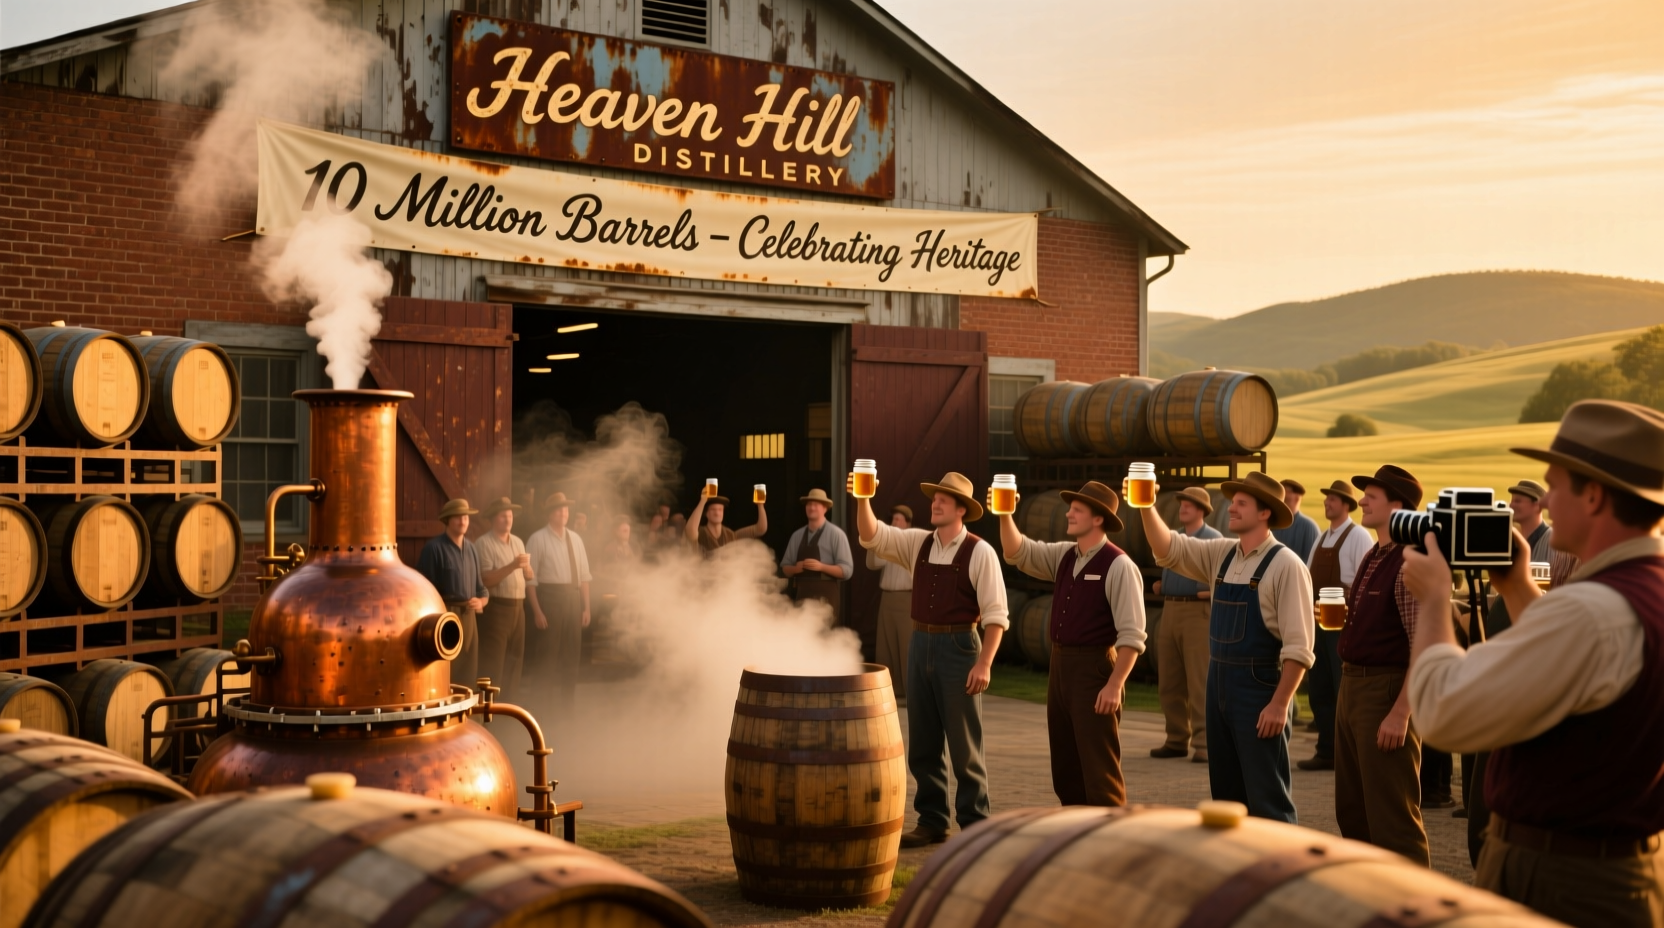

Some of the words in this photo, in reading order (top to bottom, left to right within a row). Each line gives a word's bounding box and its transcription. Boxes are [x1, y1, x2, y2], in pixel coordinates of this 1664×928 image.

[466, 47, 722, 141] Heaven
[737, 84, 860, 158] Hill
[633, 143, 843, 187] DISTILLERY
[301, 160, 368, 216] 10
[374, 172, 547, 238] Million
[555, 193, 699, 252] Barrels
[738, 214, 903, 283] Celebrating
[911, 229, 1022, 287] Heritage
